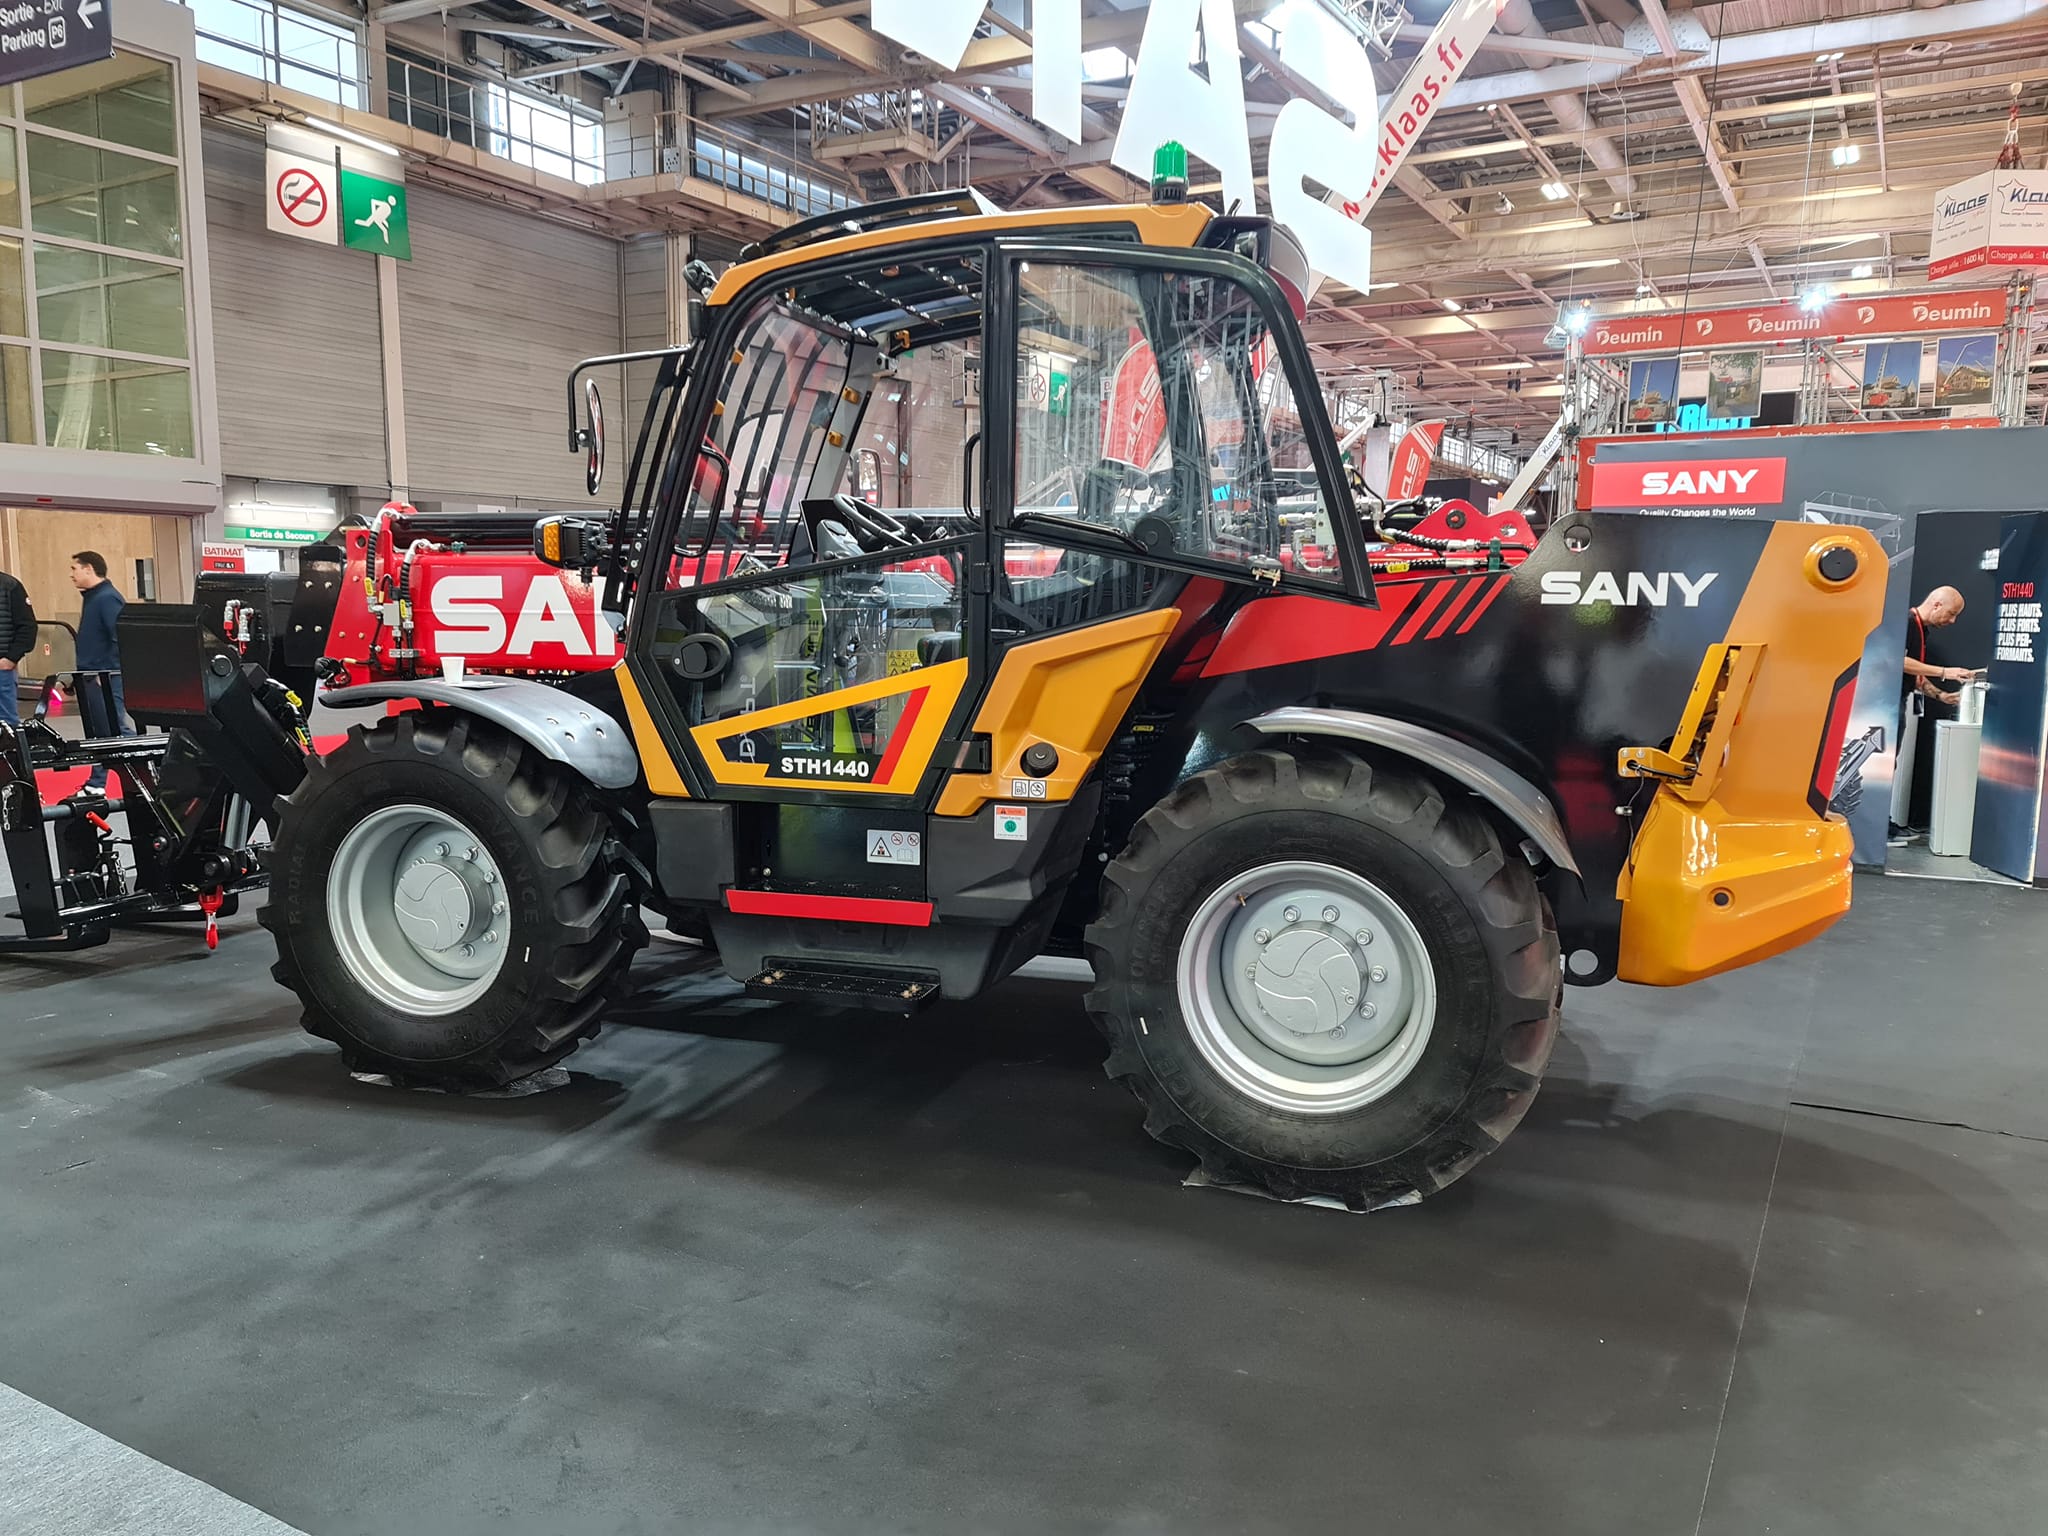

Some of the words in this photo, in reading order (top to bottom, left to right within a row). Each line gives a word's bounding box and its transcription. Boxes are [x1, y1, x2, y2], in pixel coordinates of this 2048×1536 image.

[0, 2, 34, 27] Sortie
[1, 28, 45, 54] Parking
[51, 24, 63, 40] P6
[2010, 188, 2048, 202] Kla
[1944, 193, 1990, 218] Klaas
[1929, 263, 1947, 275] Charge
[1949, 261, 1959, 270] utile
[1964, 254, 1977, 265] 1600
[1978, 252, 1985, 263] kg
[1991, 250, 2017, 261] Charge
[2019, 251, 2034, 259] utile
[1913, 301, 1991, 321] Deumin
[1748, 315, 1820, 333] Deumin
[1597, 325, 1663, 345] Deumin
[1642, 469, 1759, 496] SANY
[1671, 508, 1710, 517] Changes
[1712, 508, 1726, 516] the
[1729, 507, 1755, 516] World
[274, 530, 283, 539] de
[285, 531, 314, 540] Secours
[204, 546, 243, 557] BATIMAT
[1540, 571, 1719, 607] SANY
[2002, 582, 2034, 598] STH1440
[2000, 603, 2017, 617] PLUS
[2018, 603, 2043, 617] HAUTS.
[1999, 618, 2016, 632] PLUS
[2017, 618, 2041, 632] FORTS.
[1998, 632, 2015, 646] PLUS
[2016, 632, 2032, 647] PER-
[1996, 647, 2034, 662] FORMANTS.
[781, 757, 869, 777] STH1440
